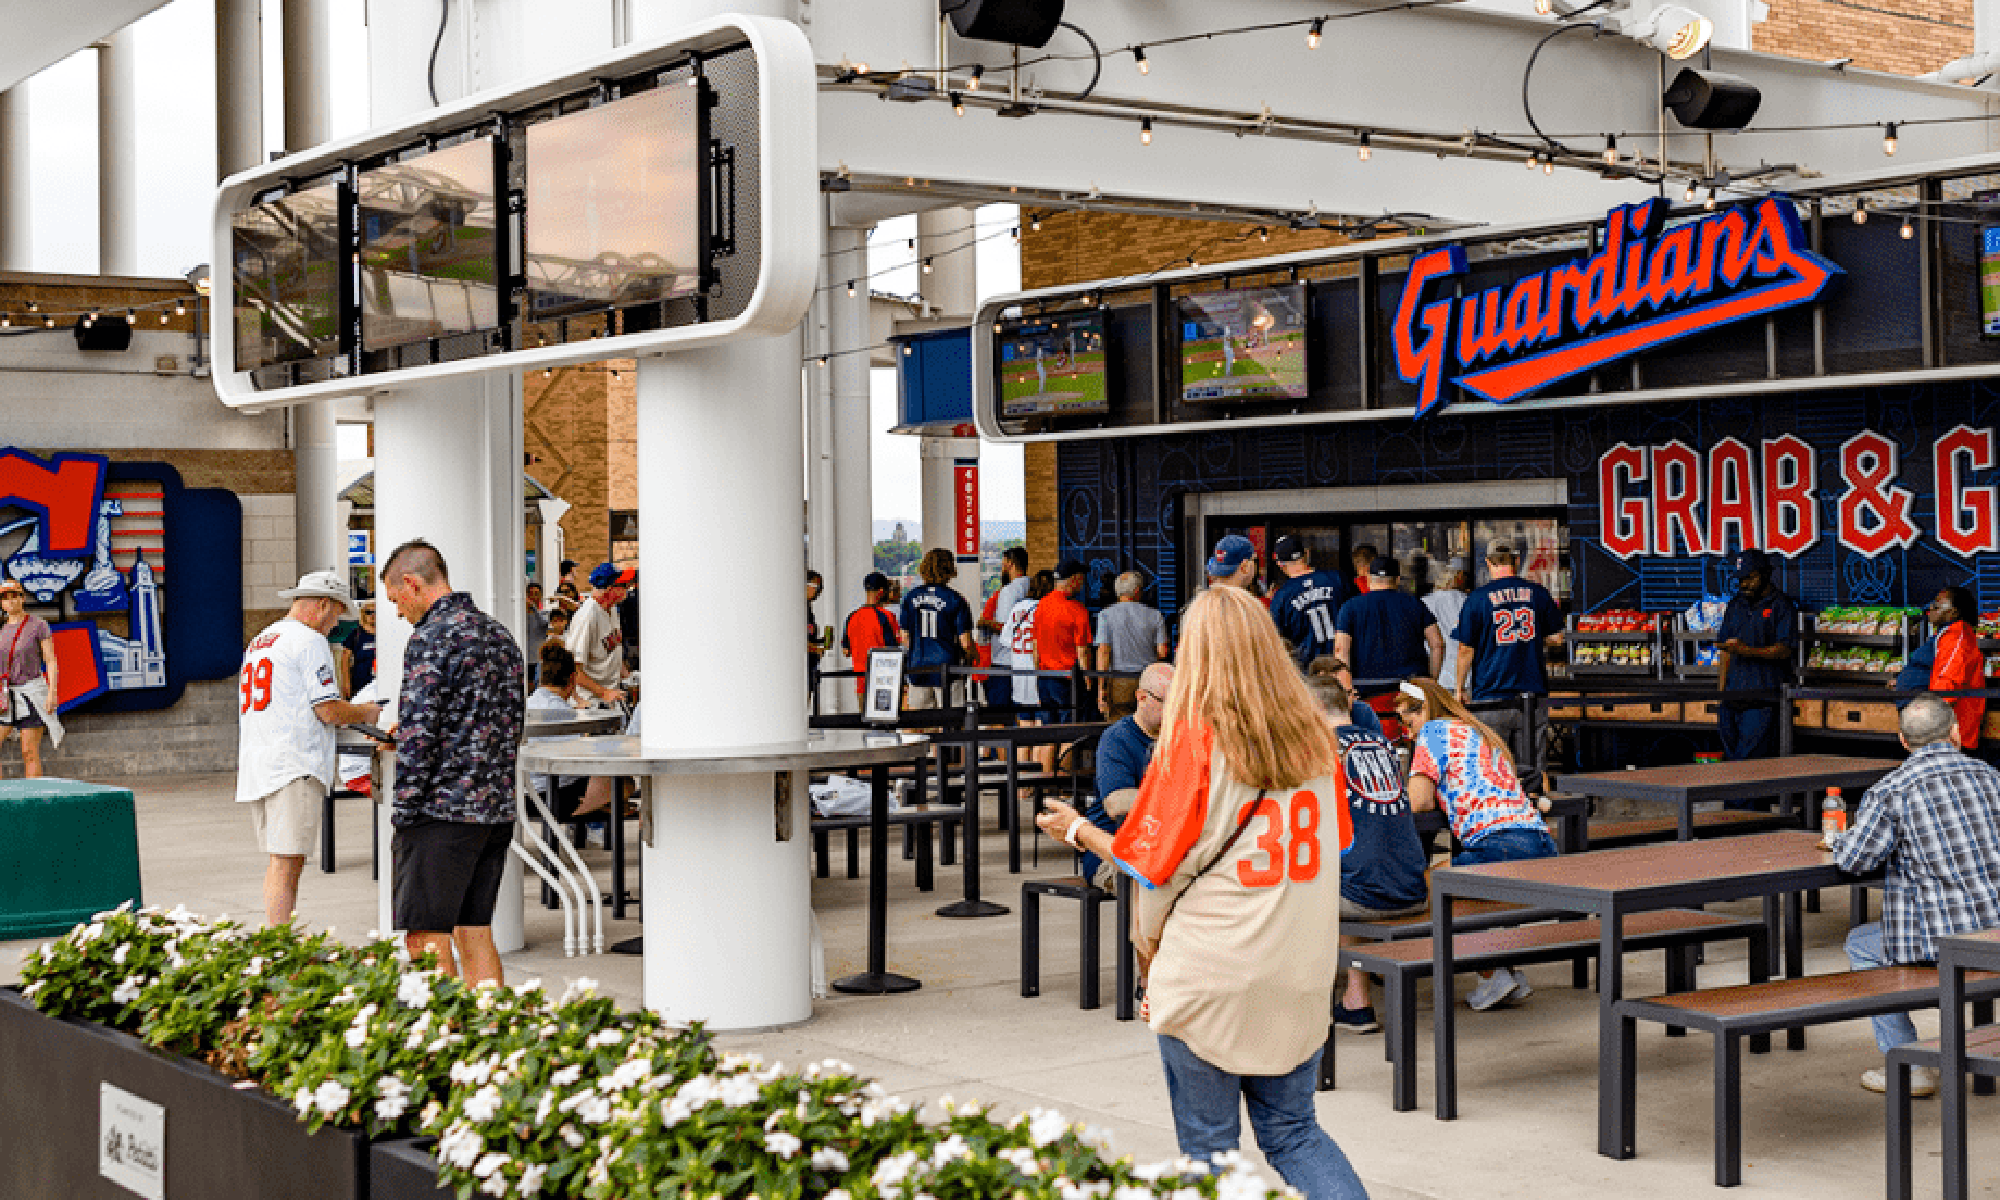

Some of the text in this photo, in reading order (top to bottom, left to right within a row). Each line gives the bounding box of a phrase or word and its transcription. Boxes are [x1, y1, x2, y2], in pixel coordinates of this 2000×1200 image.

[1393, 192, 1842, 418] Guardians
[1600, 434, 1818, 559] GRAB
[1838, 429, 1922, 559] &
[920, 609, 937, 637] 11
[1307, 604, 1335, 642] 11
[1493, 607, 1535, 645] 23
[241, 657, 273, 714] 99
[1236, 789, 1321, 888] 38
